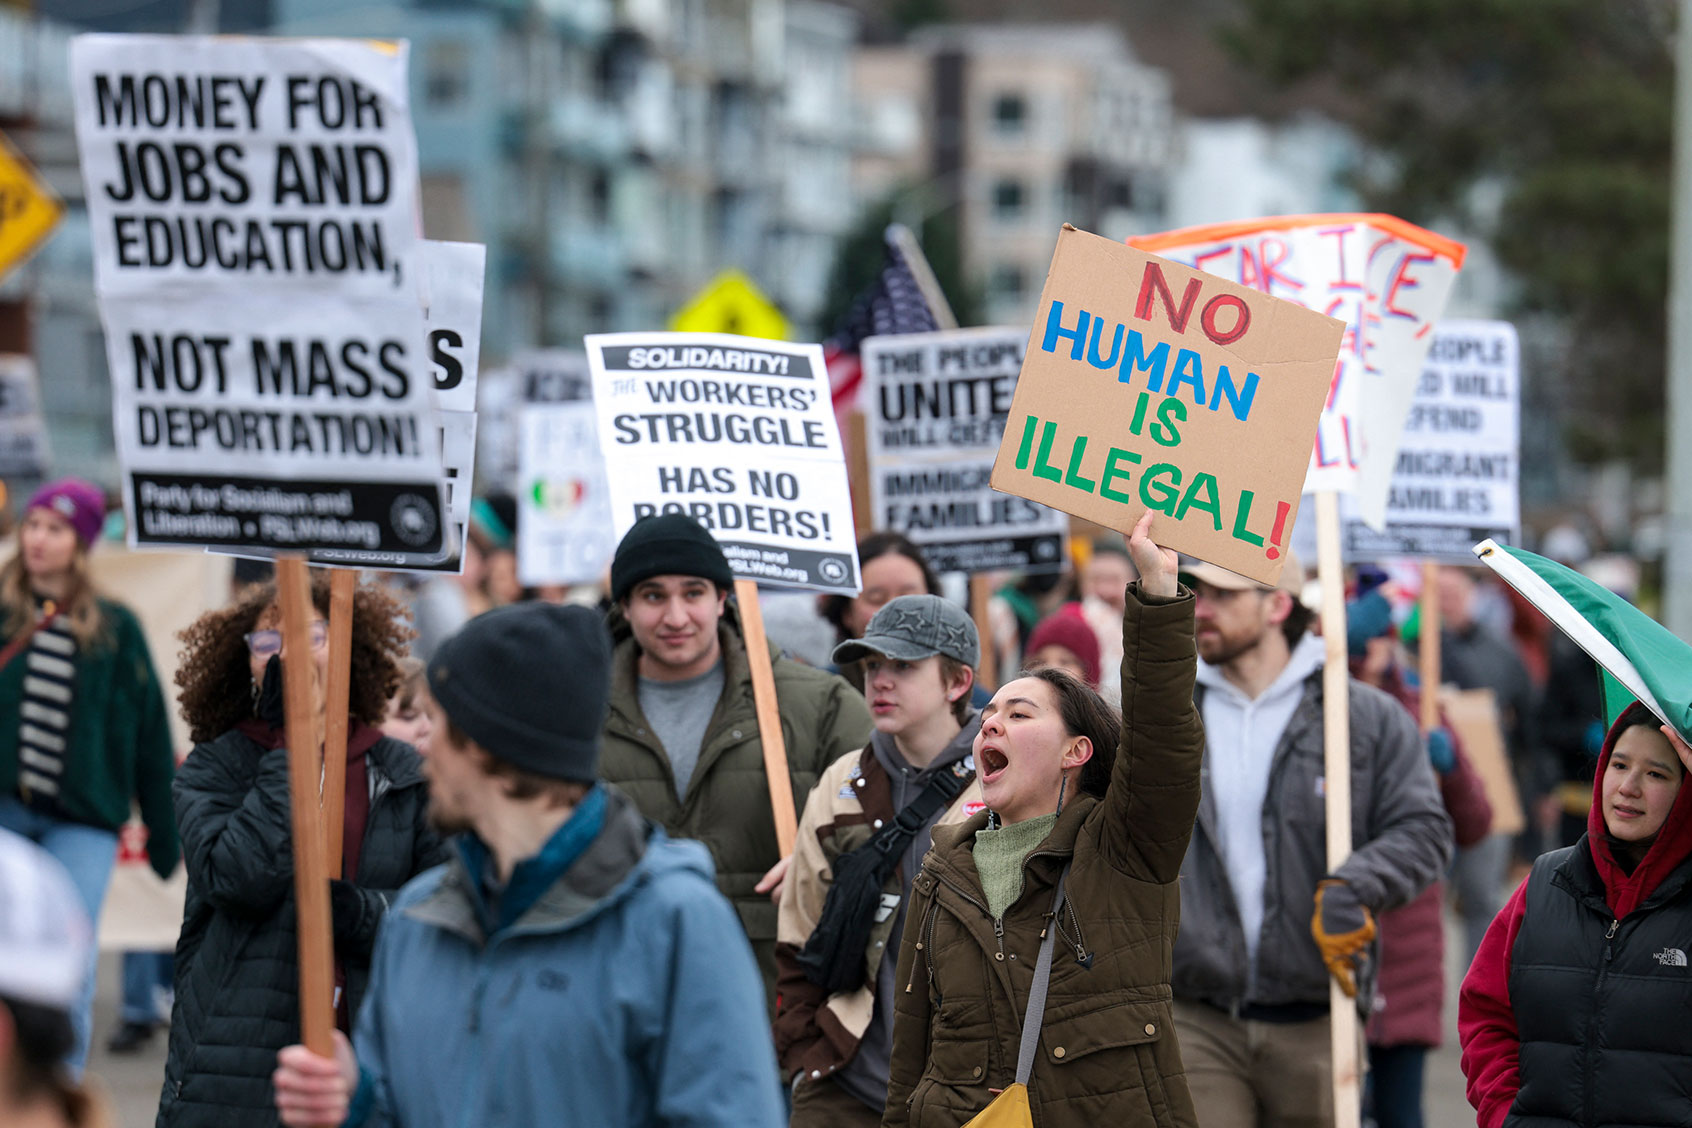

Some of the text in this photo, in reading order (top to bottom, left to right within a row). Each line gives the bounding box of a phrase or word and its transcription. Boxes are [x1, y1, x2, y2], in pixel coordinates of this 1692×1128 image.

[95, 74, 384, 130] MONEY FOR
[105, 141, 391, 206] JOBS AND
[114, 216, 401, 288] EDUCATION,
[1134, 261, 1251, 346] NO
[131, 333, 231, 394] NOT
[251, 337, 410, 400] MASS
[628, 348, 789, 375] SOLIDARITY!
[878, 351, 922, 375] THE
[1041, 300, 1261, 422] HUMAN
[1431, 336, 1506, 362] EOPLE
[645, 379, 817, 412] WORKERS'
[880, 375, 1017, 422] UNITE
[1453, 373, 1508, 398] WILL
[138, 405, 420, 457] DEPORTATION!
[614, 413, 828, 449] STRUGGLE
[1129, 392, 1188, 447] IS
[141, 481, 354, 517] Party for Socialism and
[658, 466, 800, 501] HAS NO
[1015, 415, 1291, 560] ILLEGAL!
[1387, 487, 1490, 513] AMILIES
[143, 510, 241, 540] Liberation
[762, 549, 789, 567] and
[1652, 953, 1677, 961] NORTH
[1663, 947, 1676, 955] THE
